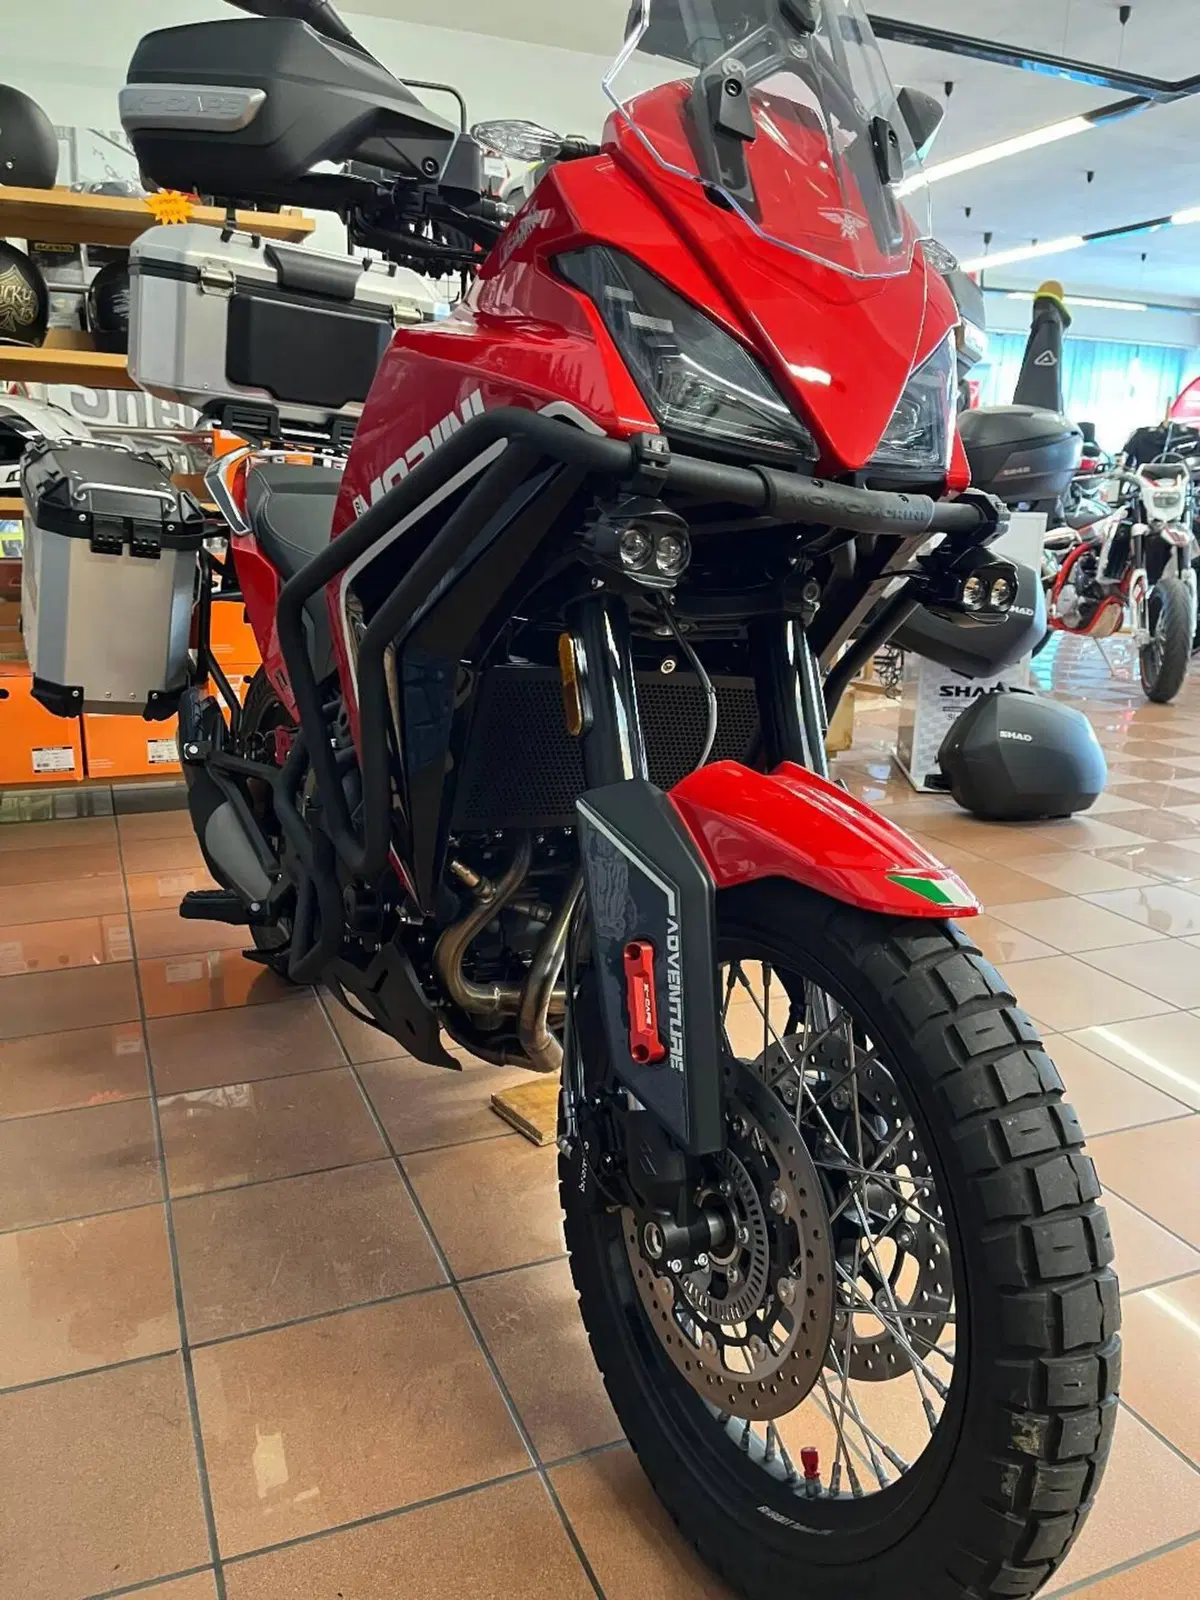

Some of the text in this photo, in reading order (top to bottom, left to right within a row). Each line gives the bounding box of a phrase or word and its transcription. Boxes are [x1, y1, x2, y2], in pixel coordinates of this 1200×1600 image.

[1008, 605, 1034, 616] HAD
[999, 730, 1032, 742] SHAD
[666, 917, 684, 1072] ADVENTURE
